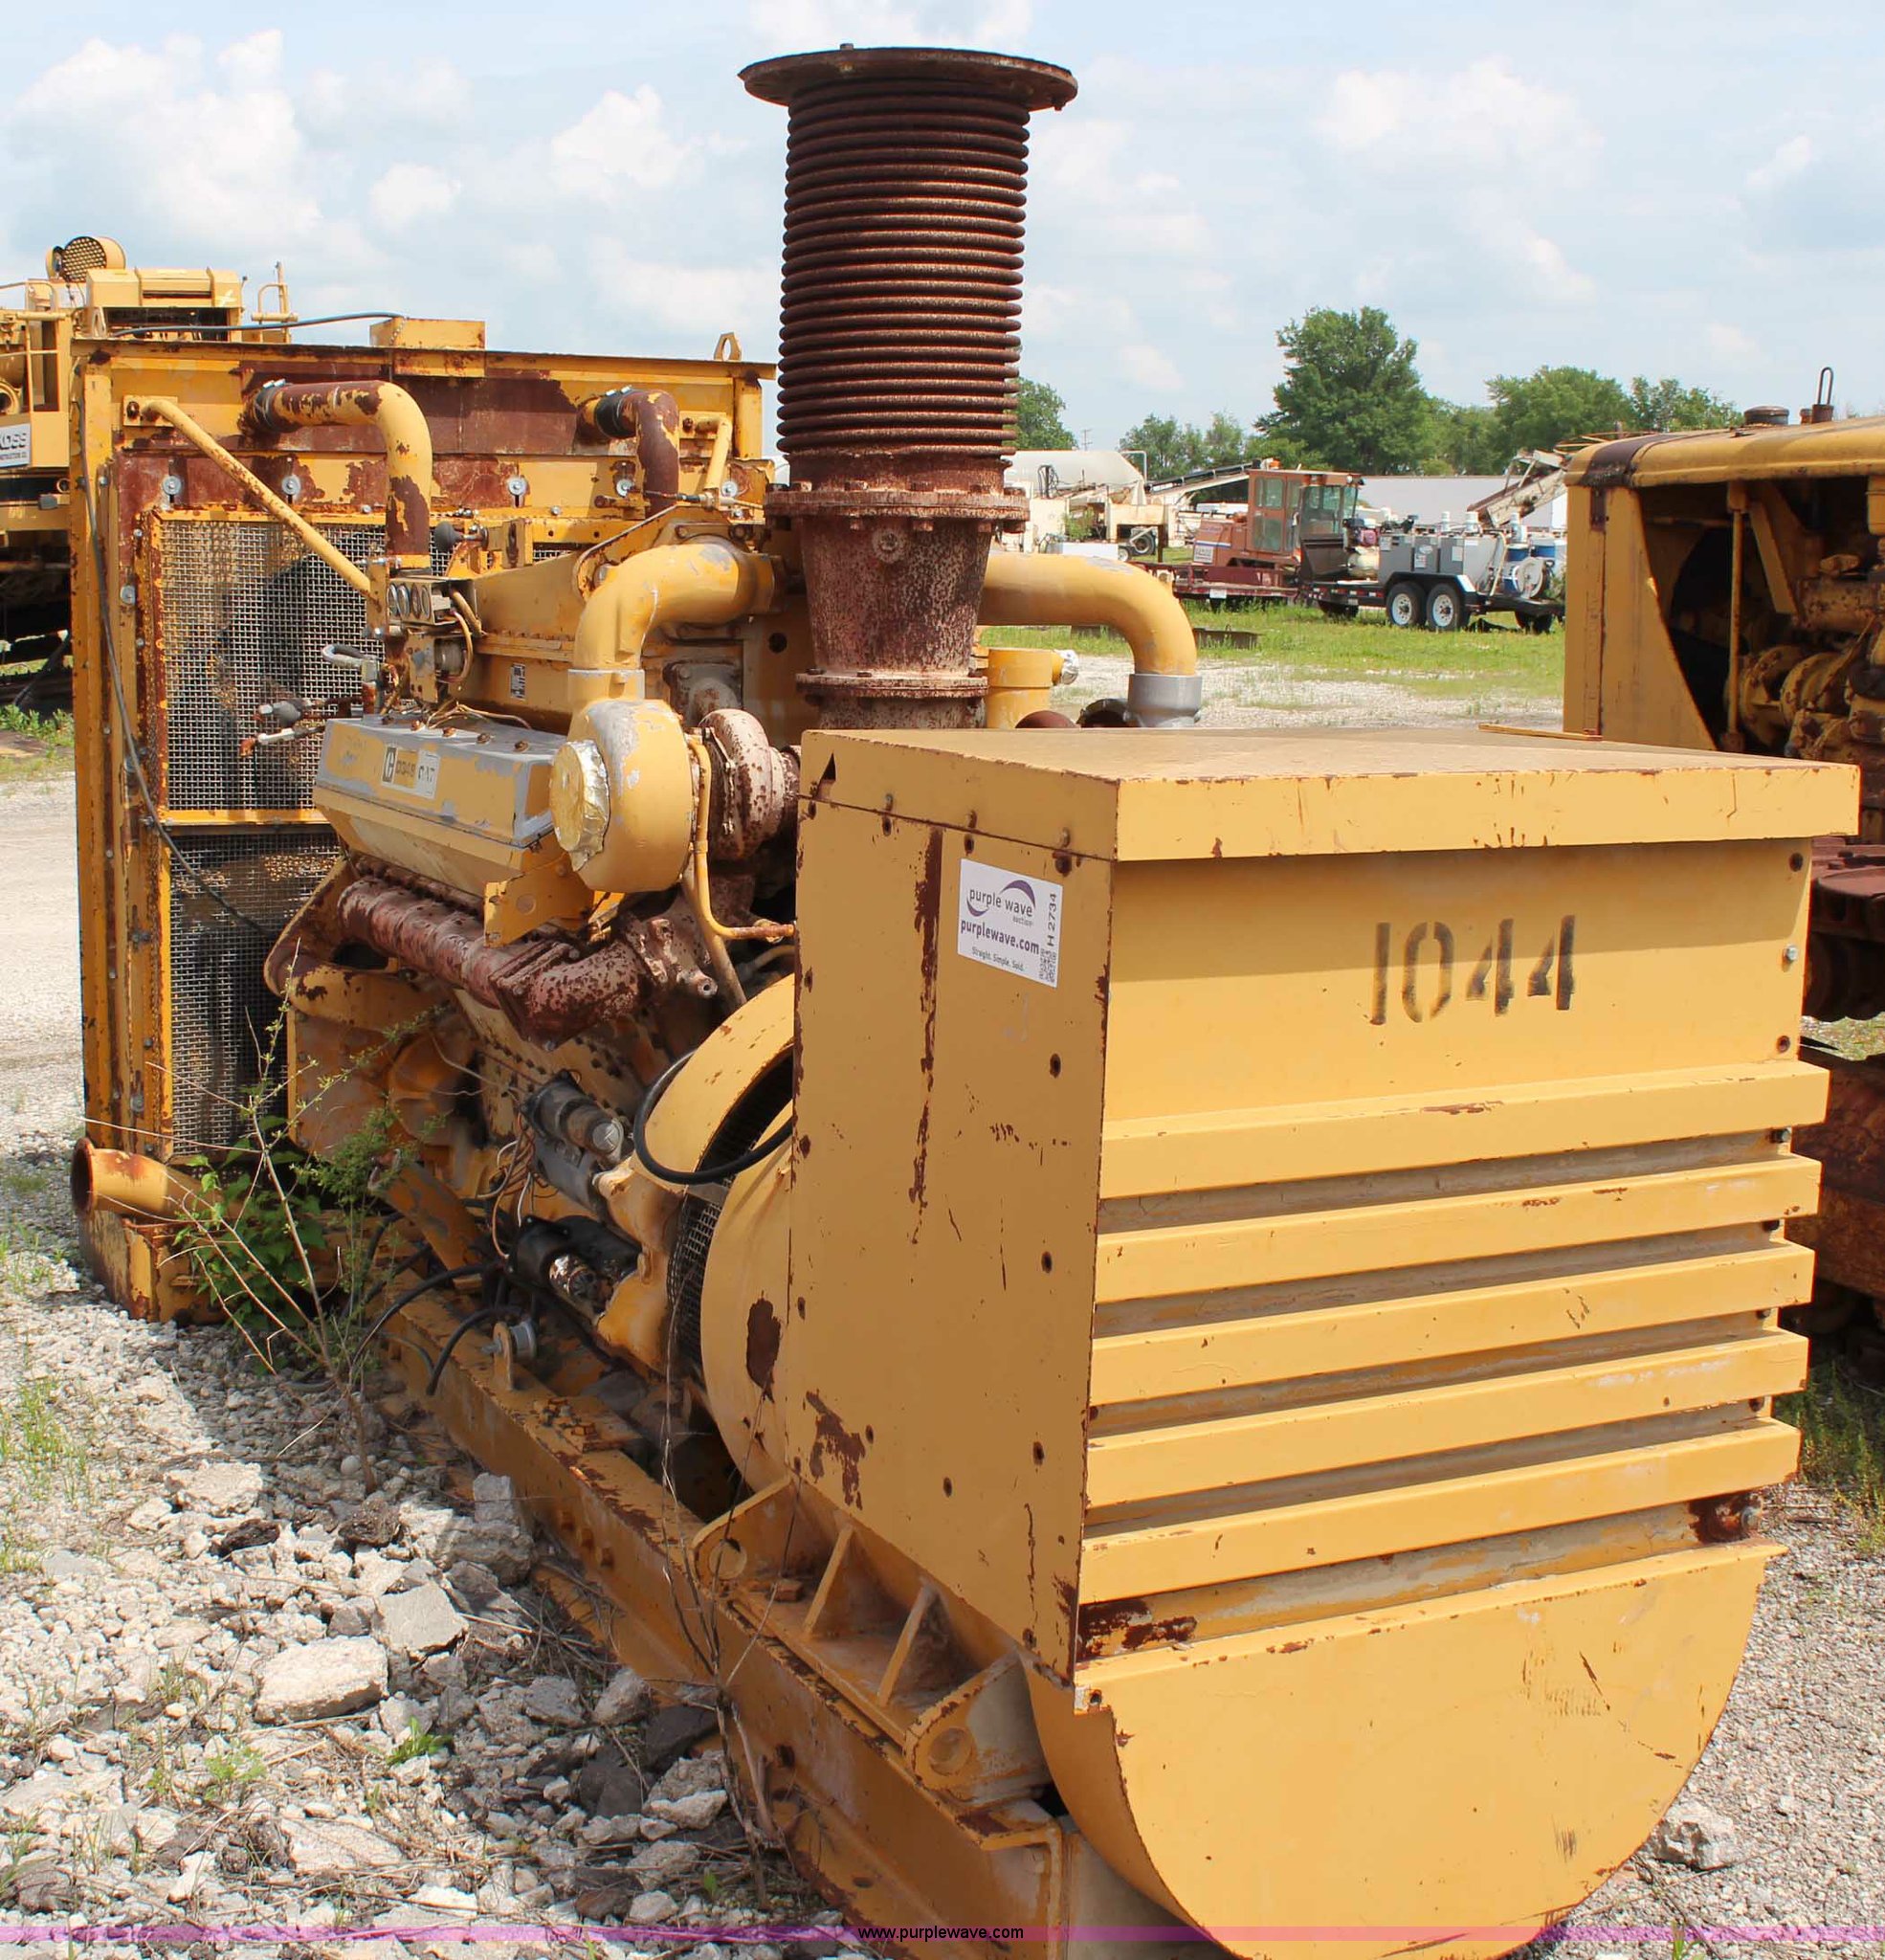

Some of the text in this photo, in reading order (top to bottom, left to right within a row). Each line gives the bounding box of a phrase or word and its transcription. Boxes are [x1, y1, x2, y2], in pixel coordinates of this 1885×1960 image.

[968, 888, 1032, 917] purple wave
[1047, 892, 1057, 947] H 2734
[961, 919, 1040, 955] purplewave.com
[1370, 914, 1576, 1025] 1044
